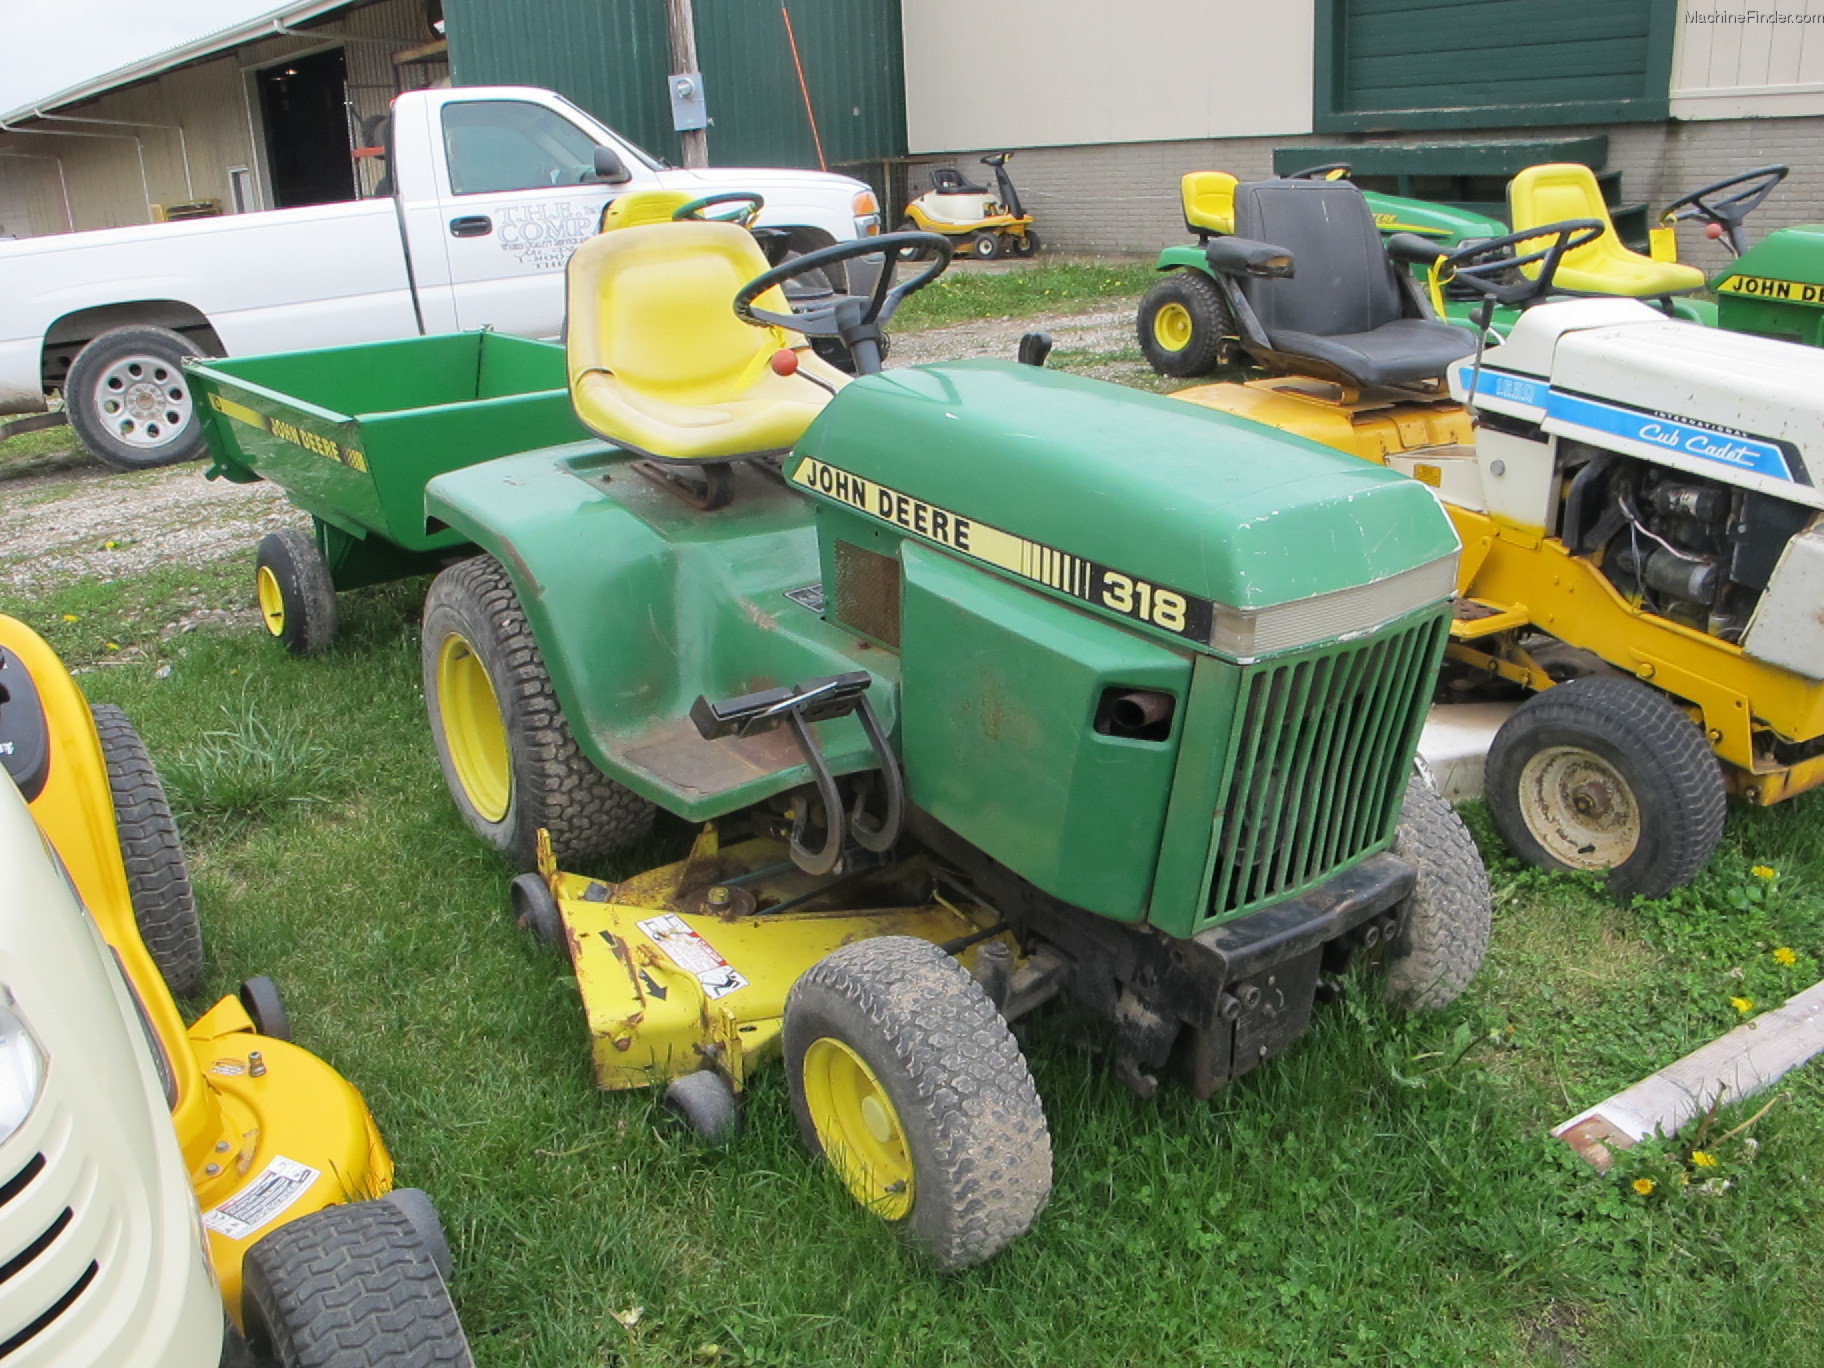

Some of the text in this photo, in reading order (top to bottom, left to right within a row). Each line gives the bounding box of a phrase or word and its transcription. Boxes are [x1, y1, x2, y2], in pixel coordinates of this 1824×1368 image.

[1732, 277, 1791, 298] JOHN
[299, 429, 343, 463] DEERE
[1639, 424, 1760, 467] Cub Cadet
[807, 461, 1187, 633] JOHN DEERE 318
